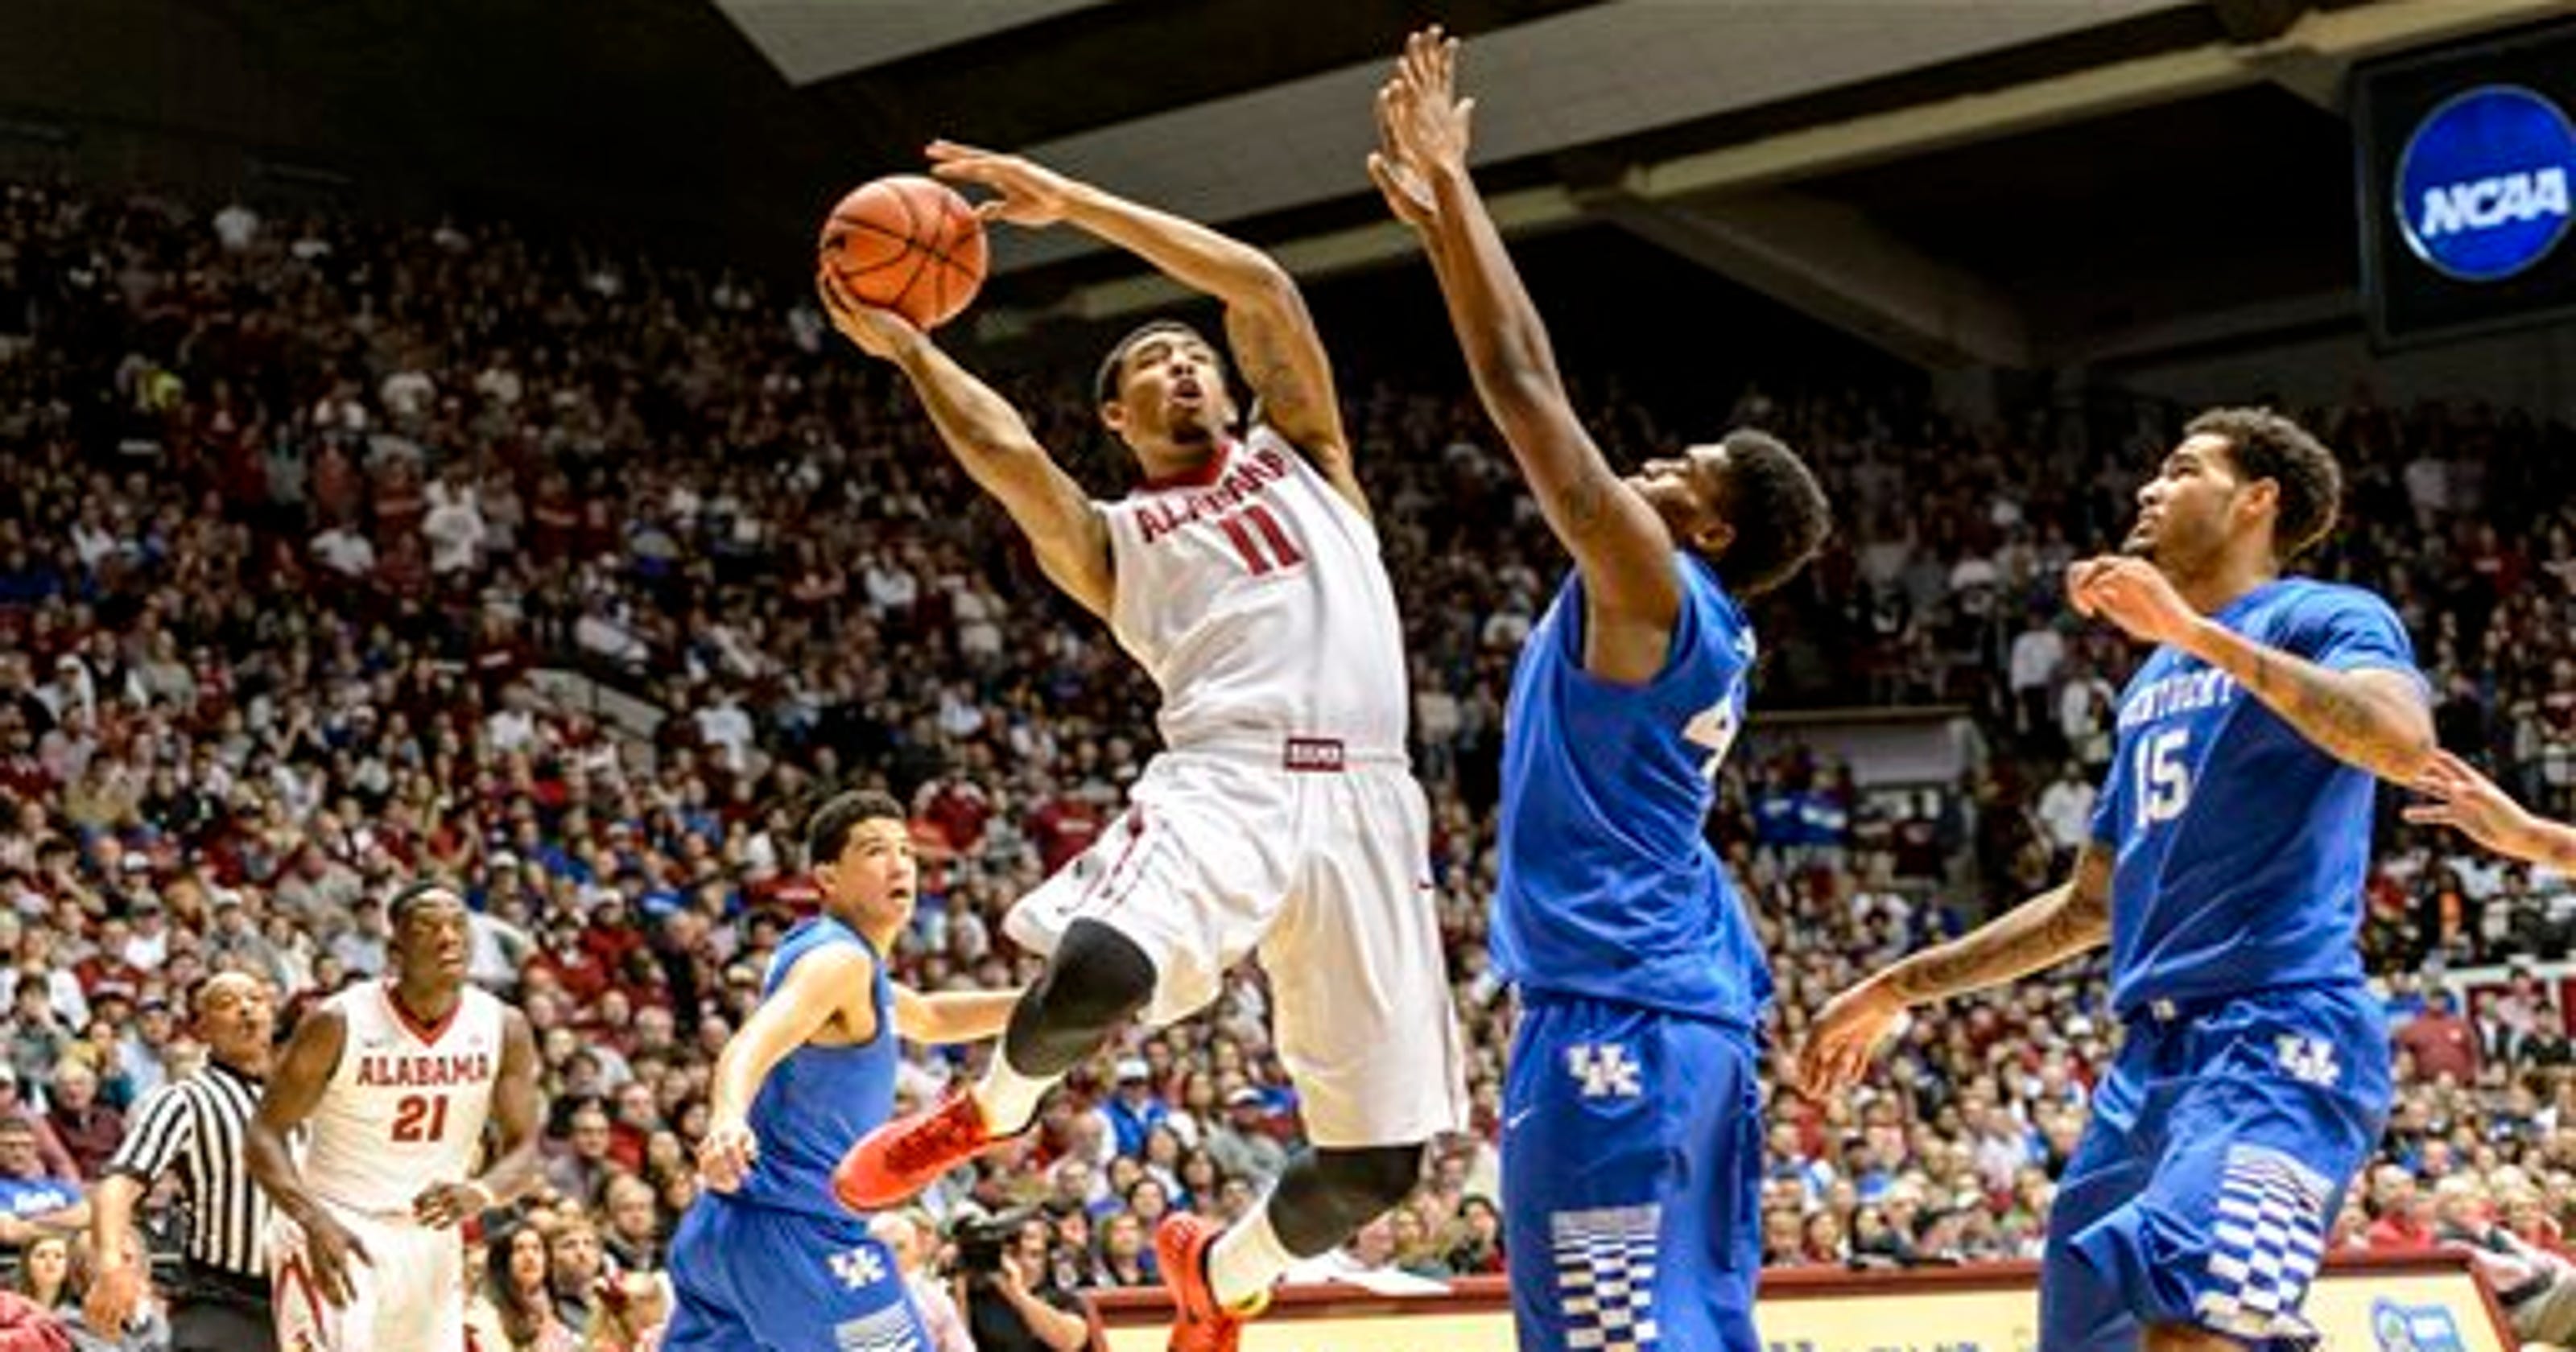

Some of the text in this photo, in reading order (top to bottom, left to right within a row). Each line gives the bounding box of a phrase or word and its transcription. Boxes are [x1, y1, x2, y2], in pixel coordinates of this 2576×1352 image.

[2420, 167, 2568, 237] NCAA
[1217, 505, 1305, 576] 11
[1680, 689, 1740, 782] 4
[2136, 727, 2190, 828] 15
[356, 1053, 489, 1086] ALABAMA
[1567, 1043, 1641, 1097] UK
[391, 1094, 448, 1143] 21
[828, 1247, 886, 1289] UK
